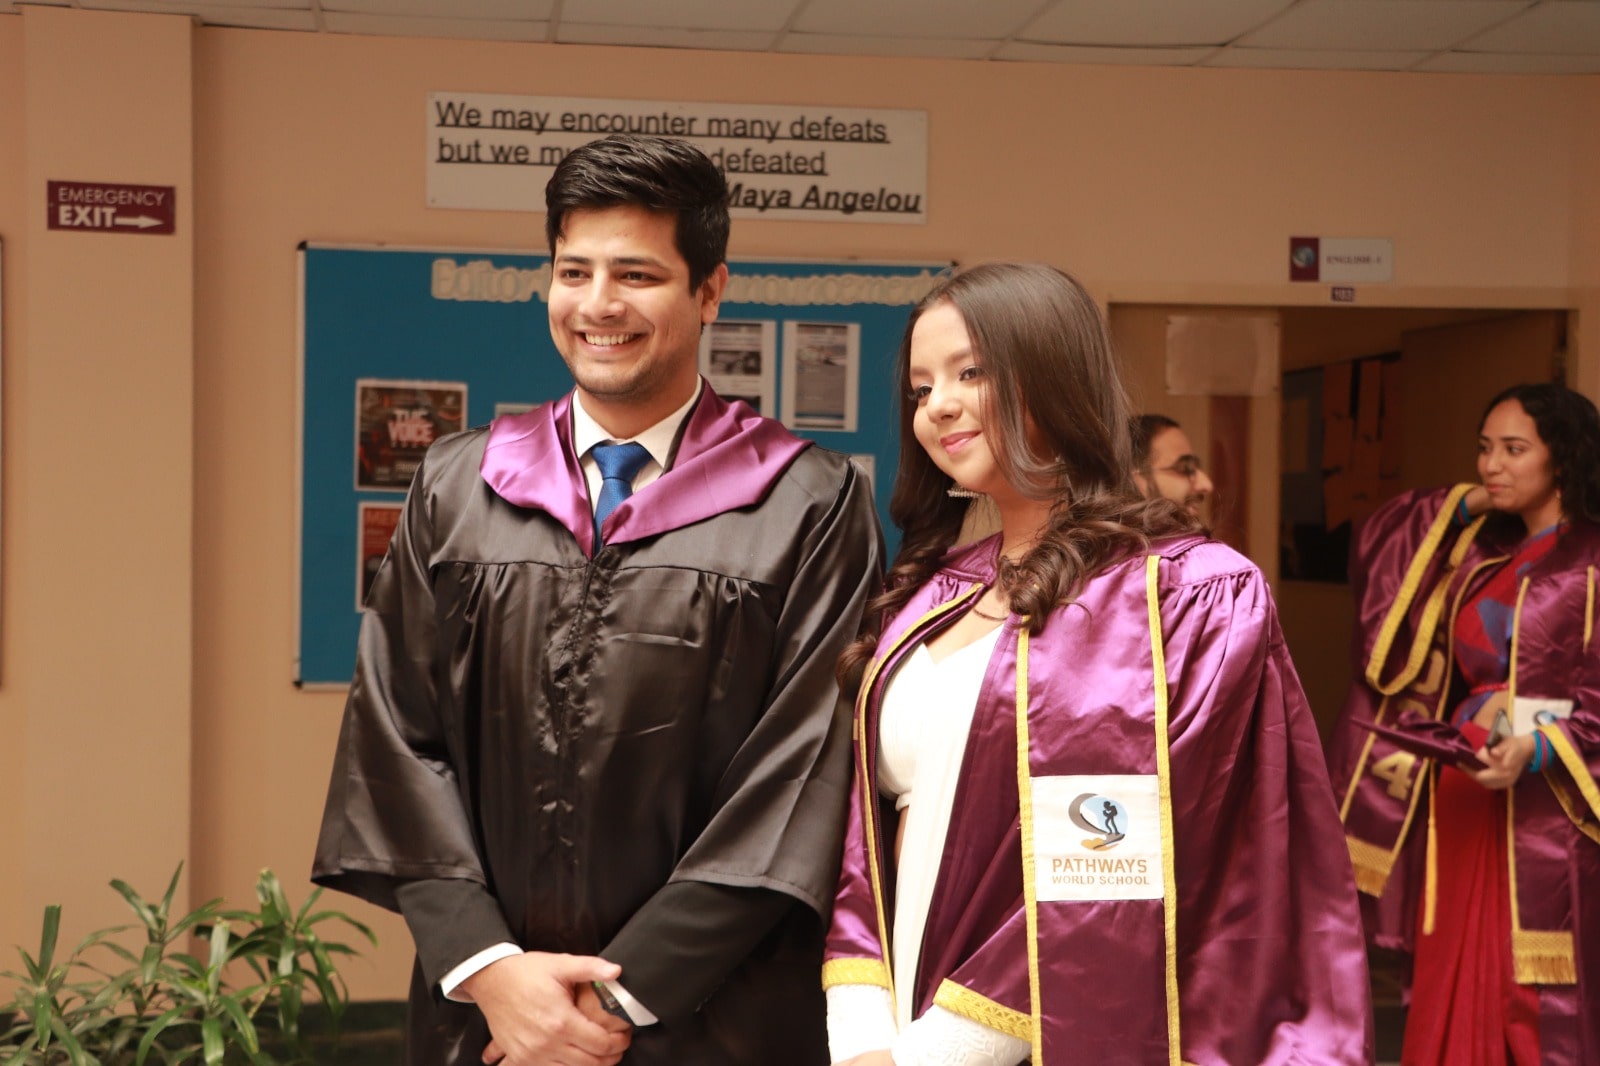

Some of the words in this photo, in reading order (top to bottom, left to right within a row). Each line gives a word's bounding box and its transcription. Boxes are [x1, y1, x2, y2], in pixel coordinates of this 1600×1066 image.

[434, 101, 481, 127] We
[491, 108, 550, 136] may
[560, 111, 698, 135] encounter
[707, 116, 781, 143] many
[789, 115, 887, 142] defeats
[438, 138, 481, 163] but
[490, 145, 529, 164] we
[711, 147, 826, 175] defeated
[57, 187, 166, 206] EMERGENCY
[800, 184, 922, 214] Angelou
[58, 205, 117, 228] EXIT
[1052, 858, 1148, 874] PATHWAYS
[1051, 875, 1095, 885] WORLD
[1099, 875, 1150, 886] SCHOOL
